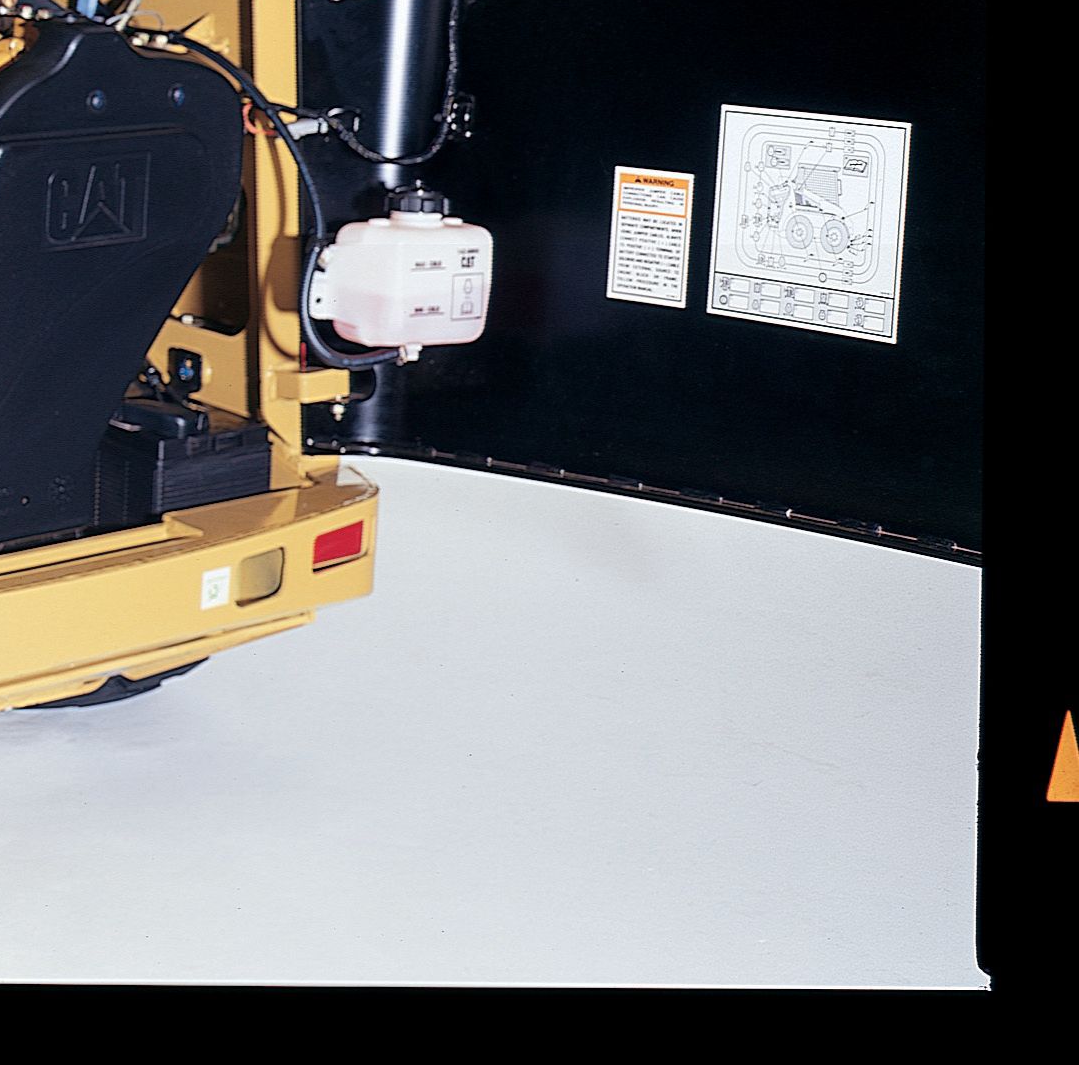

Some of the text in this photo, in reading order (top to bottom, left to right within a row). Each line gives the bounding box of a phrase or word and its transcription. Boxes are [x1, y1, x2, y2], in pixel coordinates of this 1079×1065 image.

[642, 177, 675, 188] WARNING
[45, 157, 143, 244] CAT
[461, 256, 475, 268] CAT
